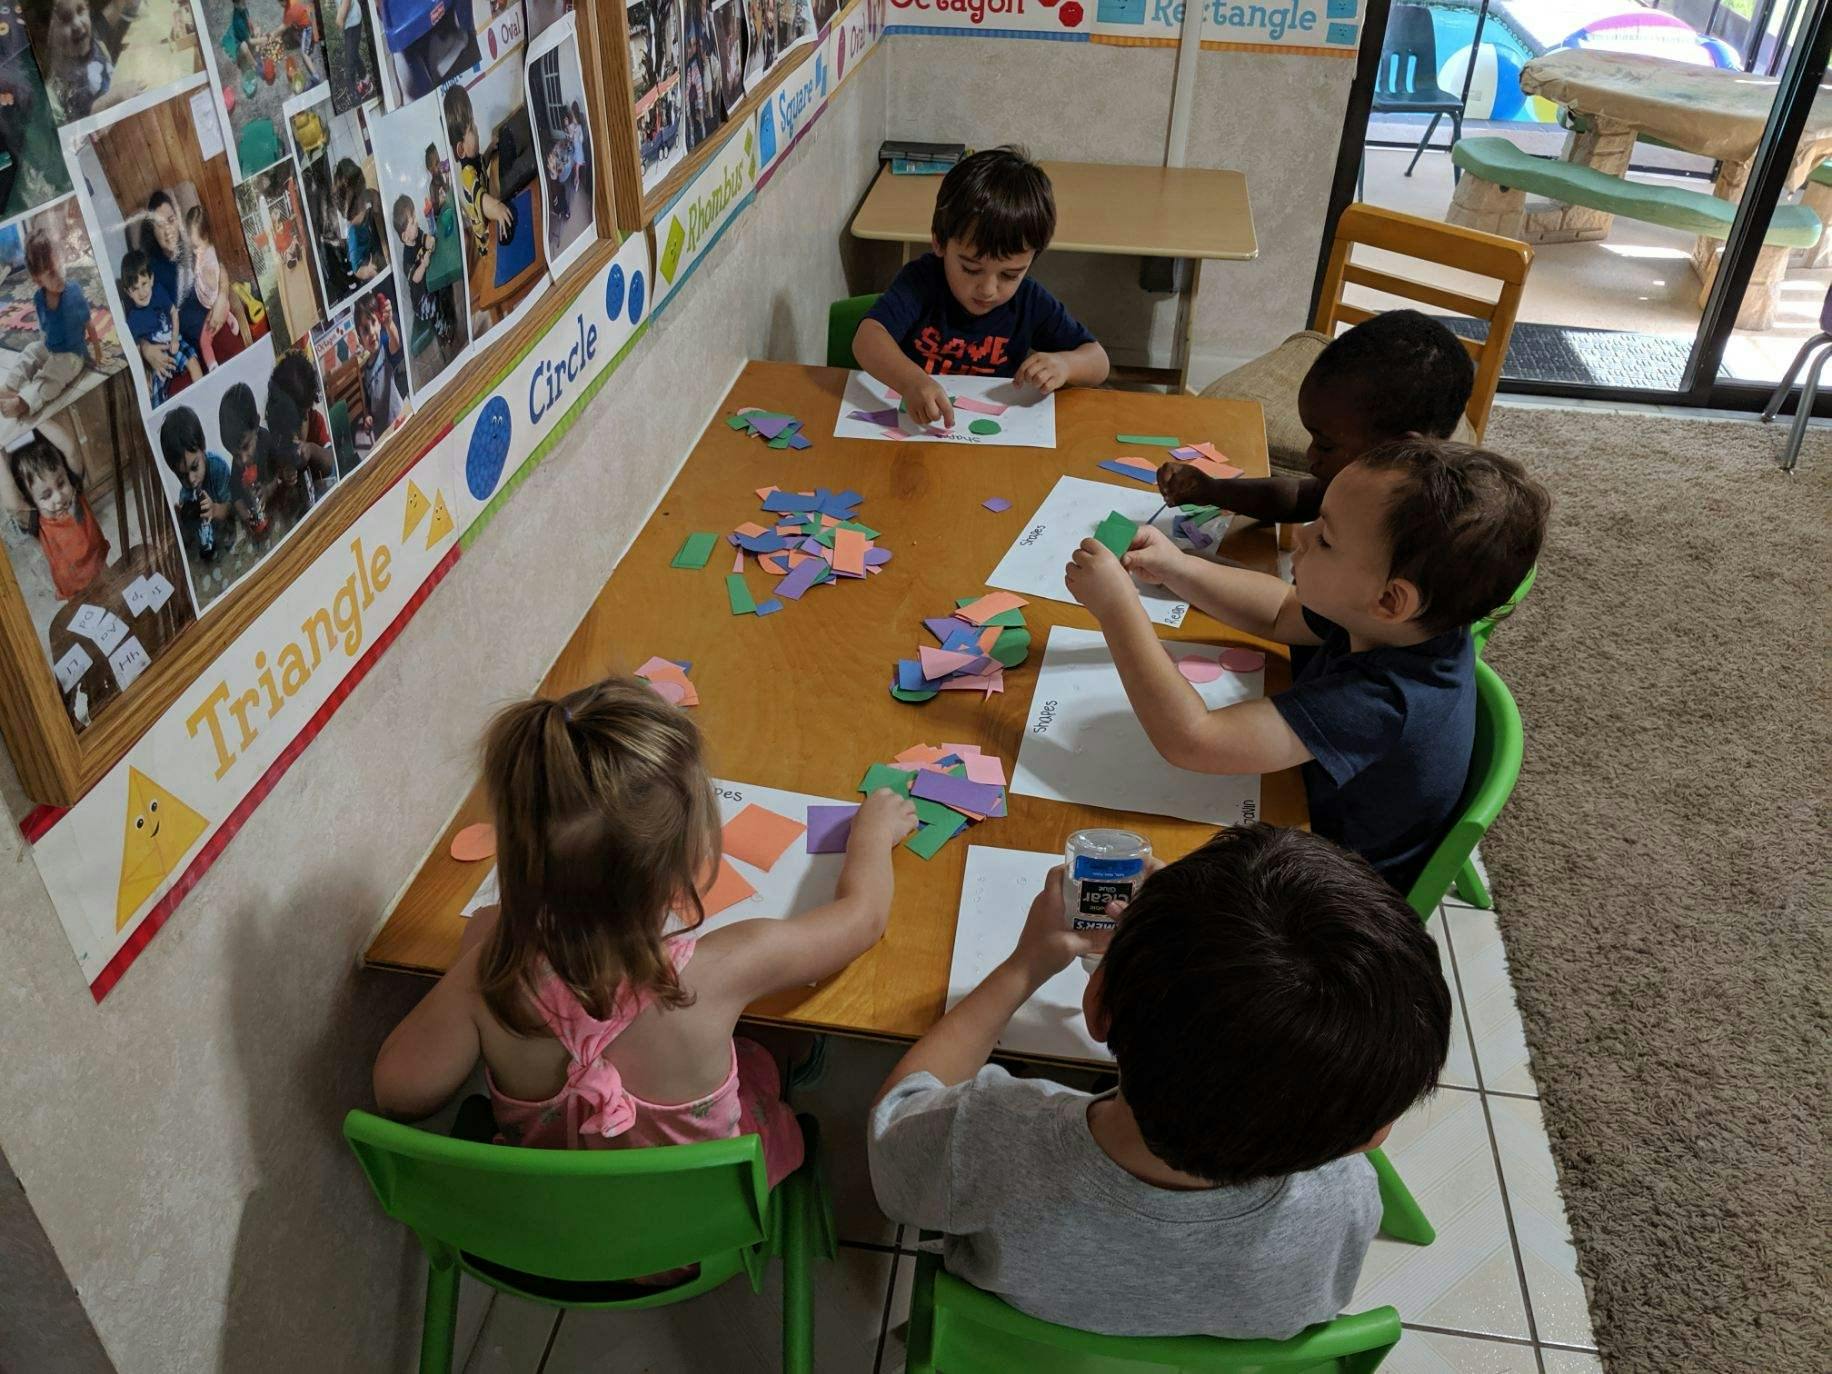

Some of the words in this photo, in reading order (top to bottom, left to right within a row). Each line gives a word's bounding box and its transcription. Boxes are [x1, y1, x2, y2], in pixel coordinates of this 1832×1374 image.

[501, 12, 521, 44] Oval
[1152, 0, 1317, 40] Retangle
[779, 79, 813, 139] Square
[687, 159, 744, 254] Rhombus
[529, 313, 598, 425] Circle
[1020, 525, 1046, 546] Shapes
[185, 536, 392, 782] Triangle
[1033, 700, 1058, 733] Shapes
[714, 787, 743, 802] pes
